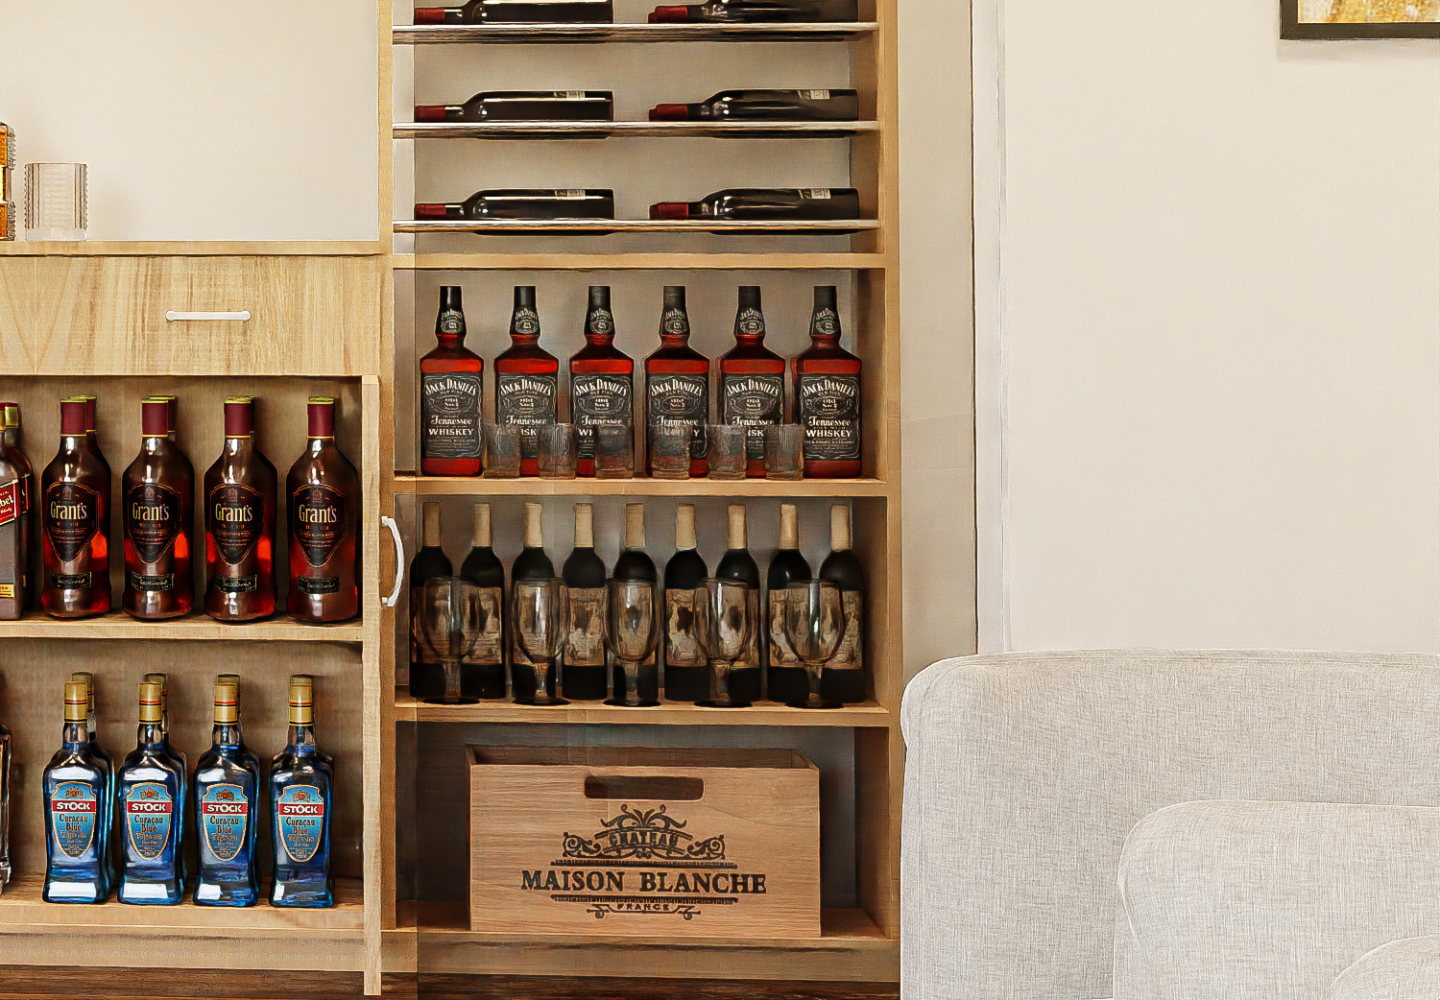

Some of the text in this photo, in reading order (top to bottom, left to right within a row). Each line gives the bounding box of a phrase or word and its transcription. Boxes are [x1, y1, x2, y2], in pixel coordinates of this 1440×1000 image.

[426, 382, 446, 395] JACK
[501, 381, 521, 396] JACK
[576, 382, 596, 396] JACK
[651, 382, 671, 396] JACK
[727, 382, 747, 396] JACK
[803, 383, 823, 396] JACK
[431, 415, 472, 424] Tennessee
[506, 415, 546, 425] Tennessee
[582, 415, 622, 425] Tennessee
[657, 415, 698, 426] Tennessee
[732, 416, 774, 425] Tennessee
[808, 416, 851, 426] Tennessee
[51, 502, 87, 519] Grant's
[132, 502, 169, 520] Grant's
[216, 504, 252, 522] Grant's
[299, 504, 336, 523] Grant's
[56, 802, 91, 811] STOCK
[132, 803, 166, 812] STOCK
[207, 804, 242, 813] STOCK
[283, 805, 318, 814] STOCK
[66, 823, 81, 831] Blue
[141, 824, 157, 832] Blue
[217, 825, 232, 834] Blue
[293, 826, 308, 834] Blue
[521, 870, 767, 894] MAISON BLANCHE
